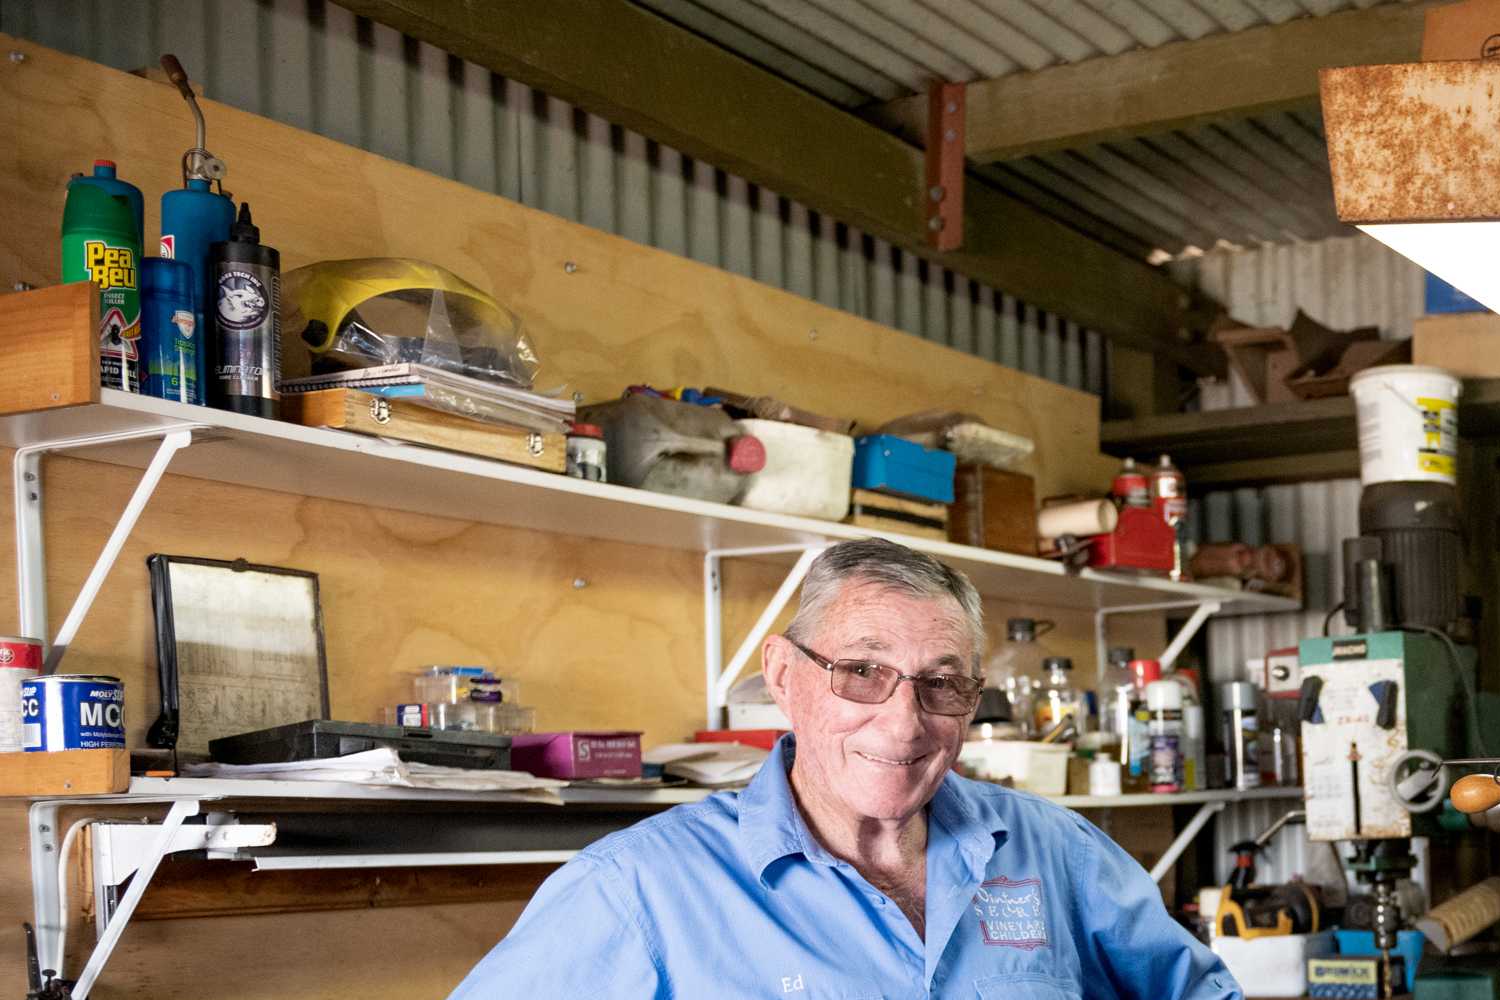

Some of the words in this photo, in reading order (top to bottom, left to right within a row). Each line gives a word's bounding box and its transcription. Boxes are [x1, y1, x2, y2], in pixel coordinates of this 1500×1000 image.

[86, 240, 133, 268] Pea
[91, 266, 137, 289] Beu
[80, 702, 126, 728] MC
[781, 974, 804, 993] Ed
